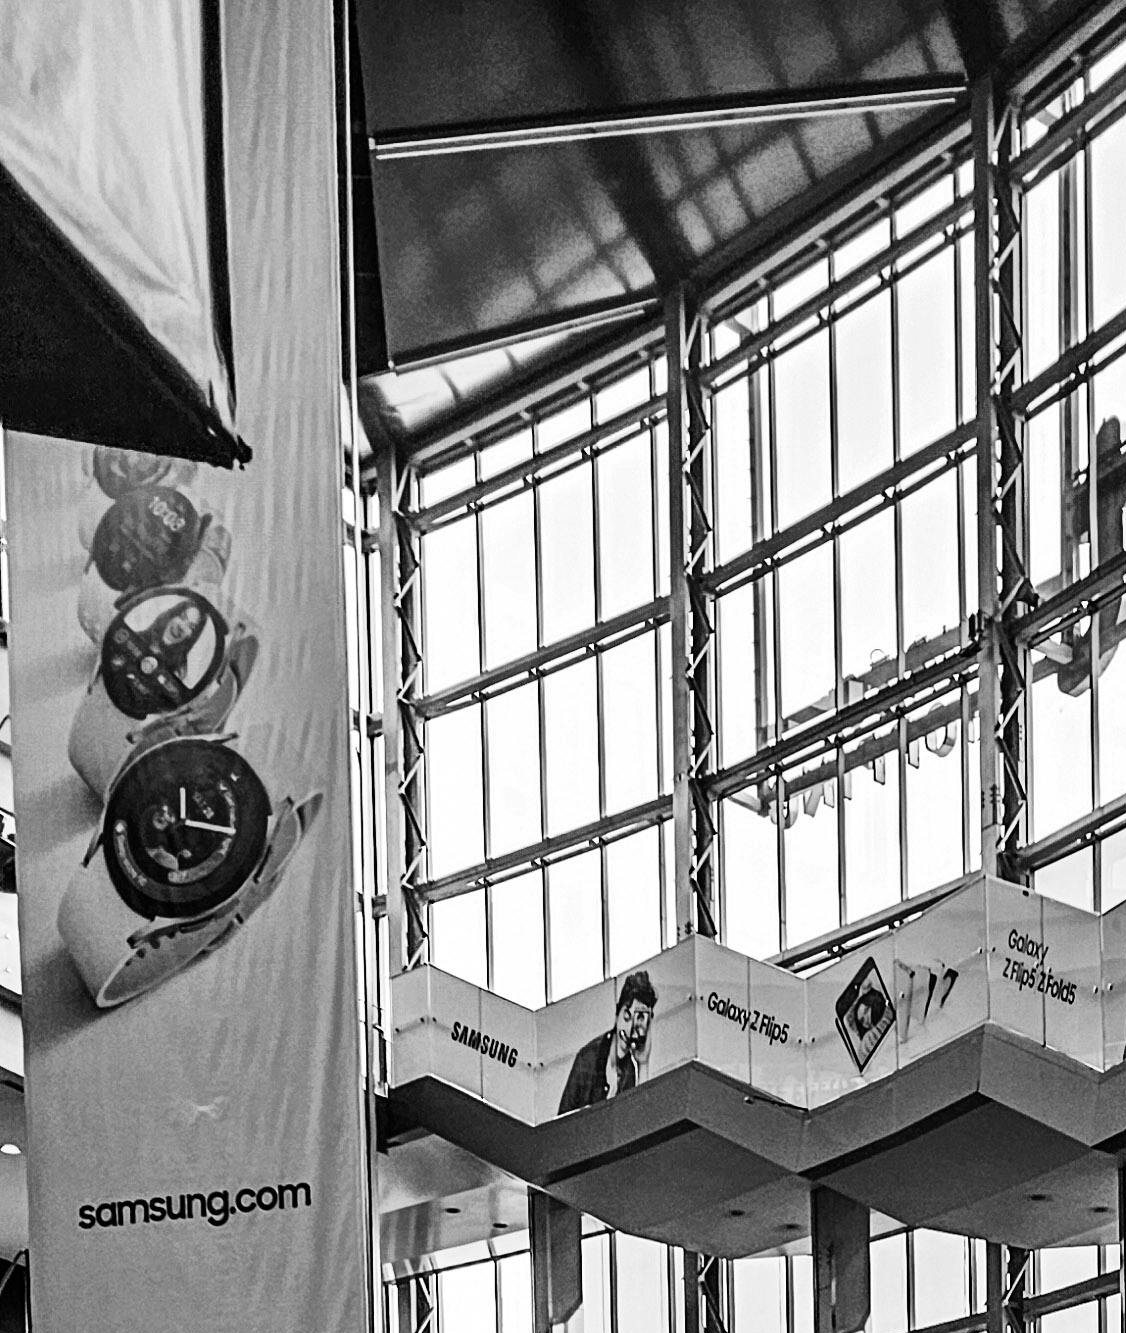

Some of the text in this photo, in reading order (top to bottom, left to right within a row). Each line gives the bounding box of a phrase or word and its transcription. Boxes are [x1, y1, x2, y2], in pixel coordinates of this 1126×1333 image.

[1008, 929, 1048, 963] Galaxy
[1002, 958, 1011, 978] Z
[1011, 963, 1037, 991] Flip5
[1045, 973, 1077, 1006] Fold5
[707, 991, 790, 1046] Galaxy Z Flip5
[451, 1021, 517, 1068] SAMSUNG
[78, 1181, 312, 1229] samsung.com
